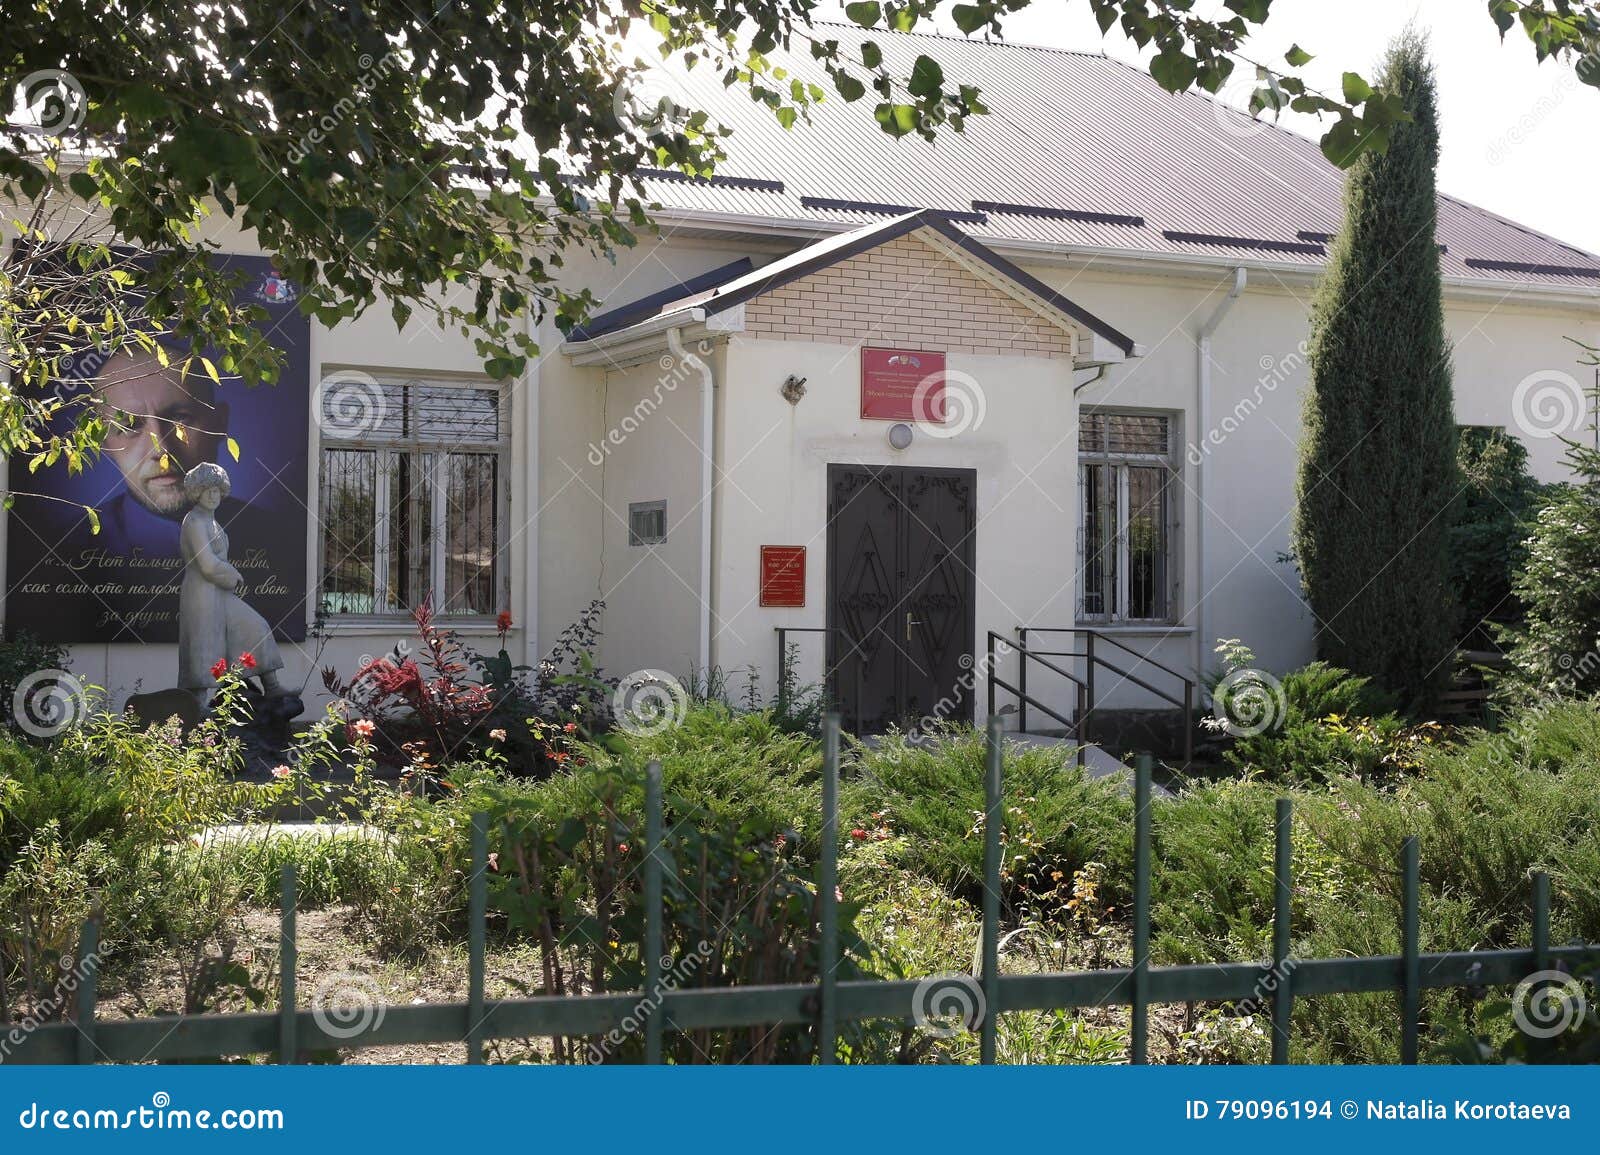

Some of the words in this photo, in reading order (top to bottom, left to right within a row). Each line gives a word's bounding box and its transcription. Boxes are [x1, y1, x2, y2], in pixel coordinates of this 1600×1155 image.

[21, 584, 50, 593] как
[56, 584, 89, 593] если
[128, 585, 182, 595] полож
